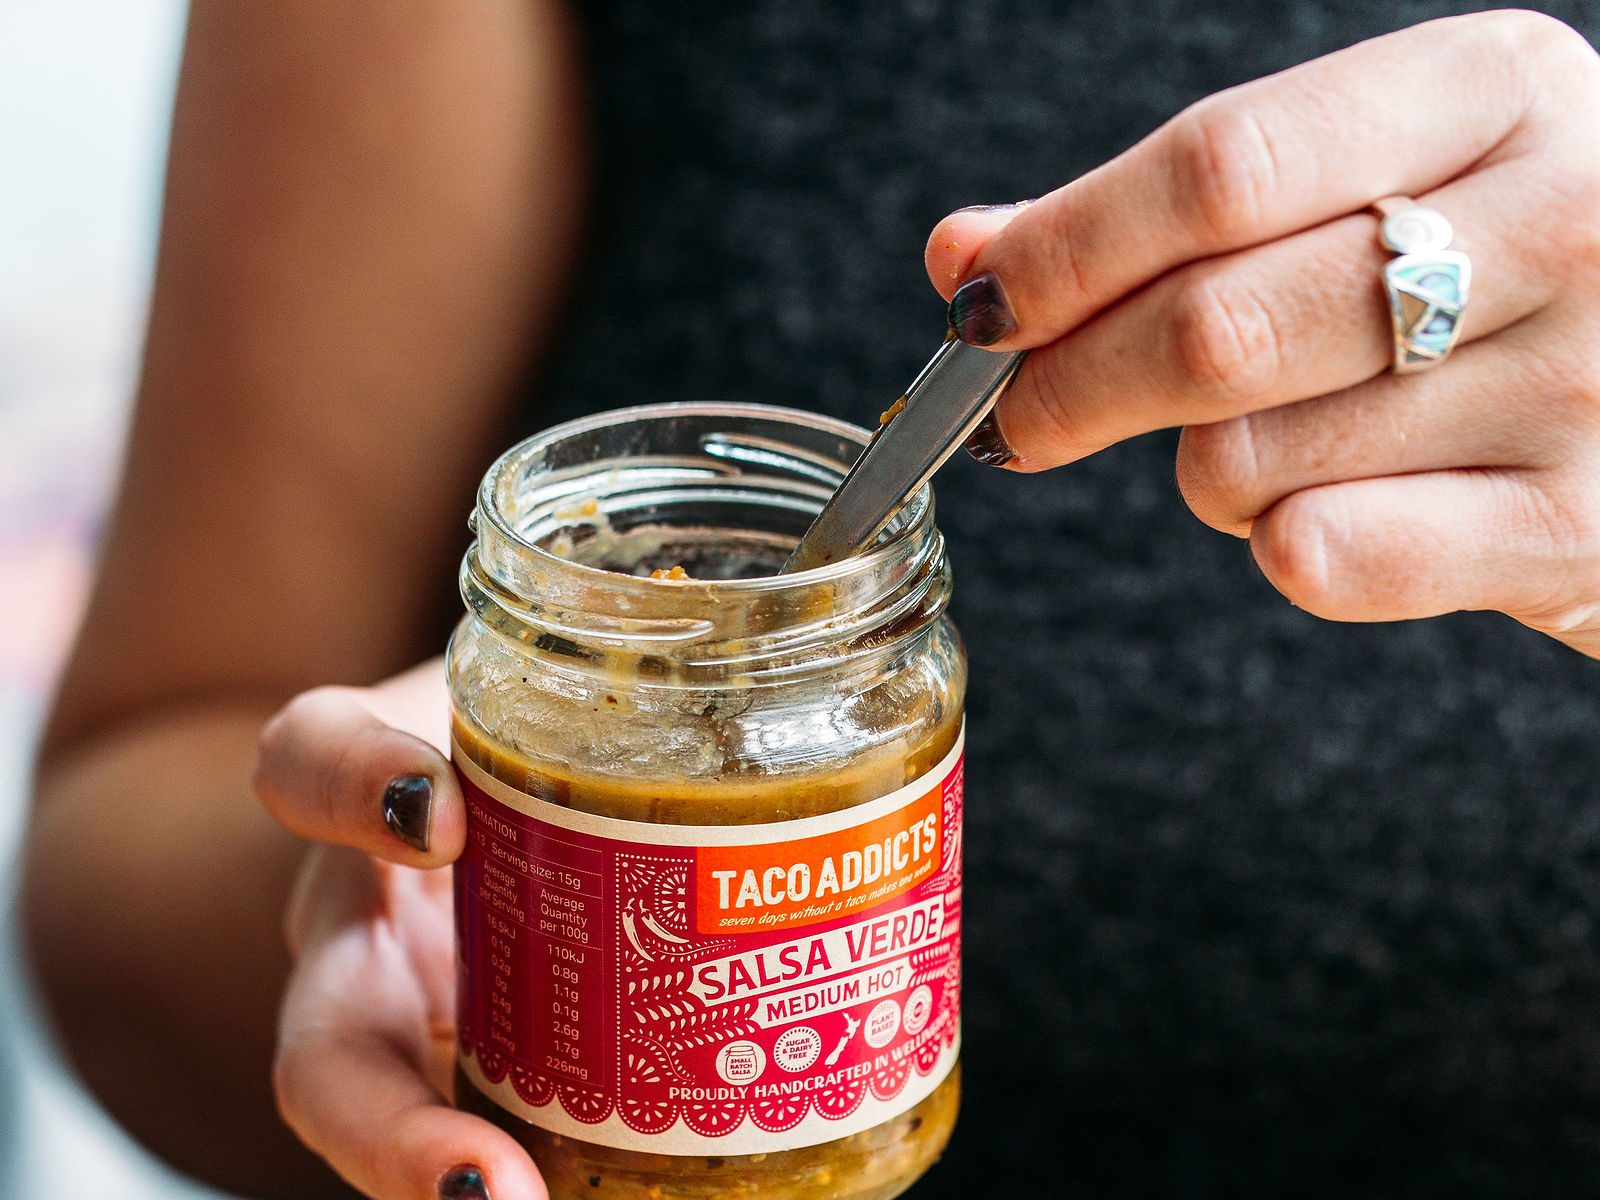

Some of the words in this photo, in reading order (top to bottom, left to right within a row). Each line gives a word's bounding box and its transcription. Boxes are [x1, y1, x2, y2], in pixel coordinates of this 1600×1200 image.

[483, 860, 516, 887] Average
[491, 842, 528, 872] Serving
[530, 863, 555, 881] size:
[558, 872, 581, 890] 15g
[711, 862, 811, 910] TACO
[815, 812, 937, 898] ADDICTS
[483, 874, 518, 905] Quantity
[540, 888, 585, 912] Average
[719, 916, 755, 927] seven
[759, 911, 786, 925] days
[789, 903, 834, 920] without
[835, 901, 842, 911] a
[845, 894, 867, 909] taco
[868, 881, 898, 900] makes
[898, 872, 913, 888] one
[492, 892, 525, 922] Serving
[540, 903, 588, 928] Quantity
[540, 919, 558, 932] per
[560, 924, 589, 944] 100g
[547, 944, 585, 964] 110kJ
[695, 938, 833, 1001] SALSA
[845, 903, 940, 963] VERDE
[552, 964, 579, 984] 0.8g
[553, 983, 579, 1003] 1.1g
[766, 980, 861, 1023] MEDIUM
[866, 965, 904, 994] HOT
[552, 1002, 579, 1022] 0.1g
[871, 1012, 894, 1026] PLANT
[553, 1021, 580, 1041] 2.6g
[785, 1037, 810, 1047] SUGAR
[554, 1040, 580, 1060] 1.7g
[788, 1052, 808, 1060] FREE
[789, 1043, 813, 1054] DAIRY
[545, 1055, 588, 1080] 226mg
[669, 1086, 748, 1101] PROUDLY
[755, 1060, 872, 1099] HANDCRAFTED
[874, 1053, 889, 1070] IN
